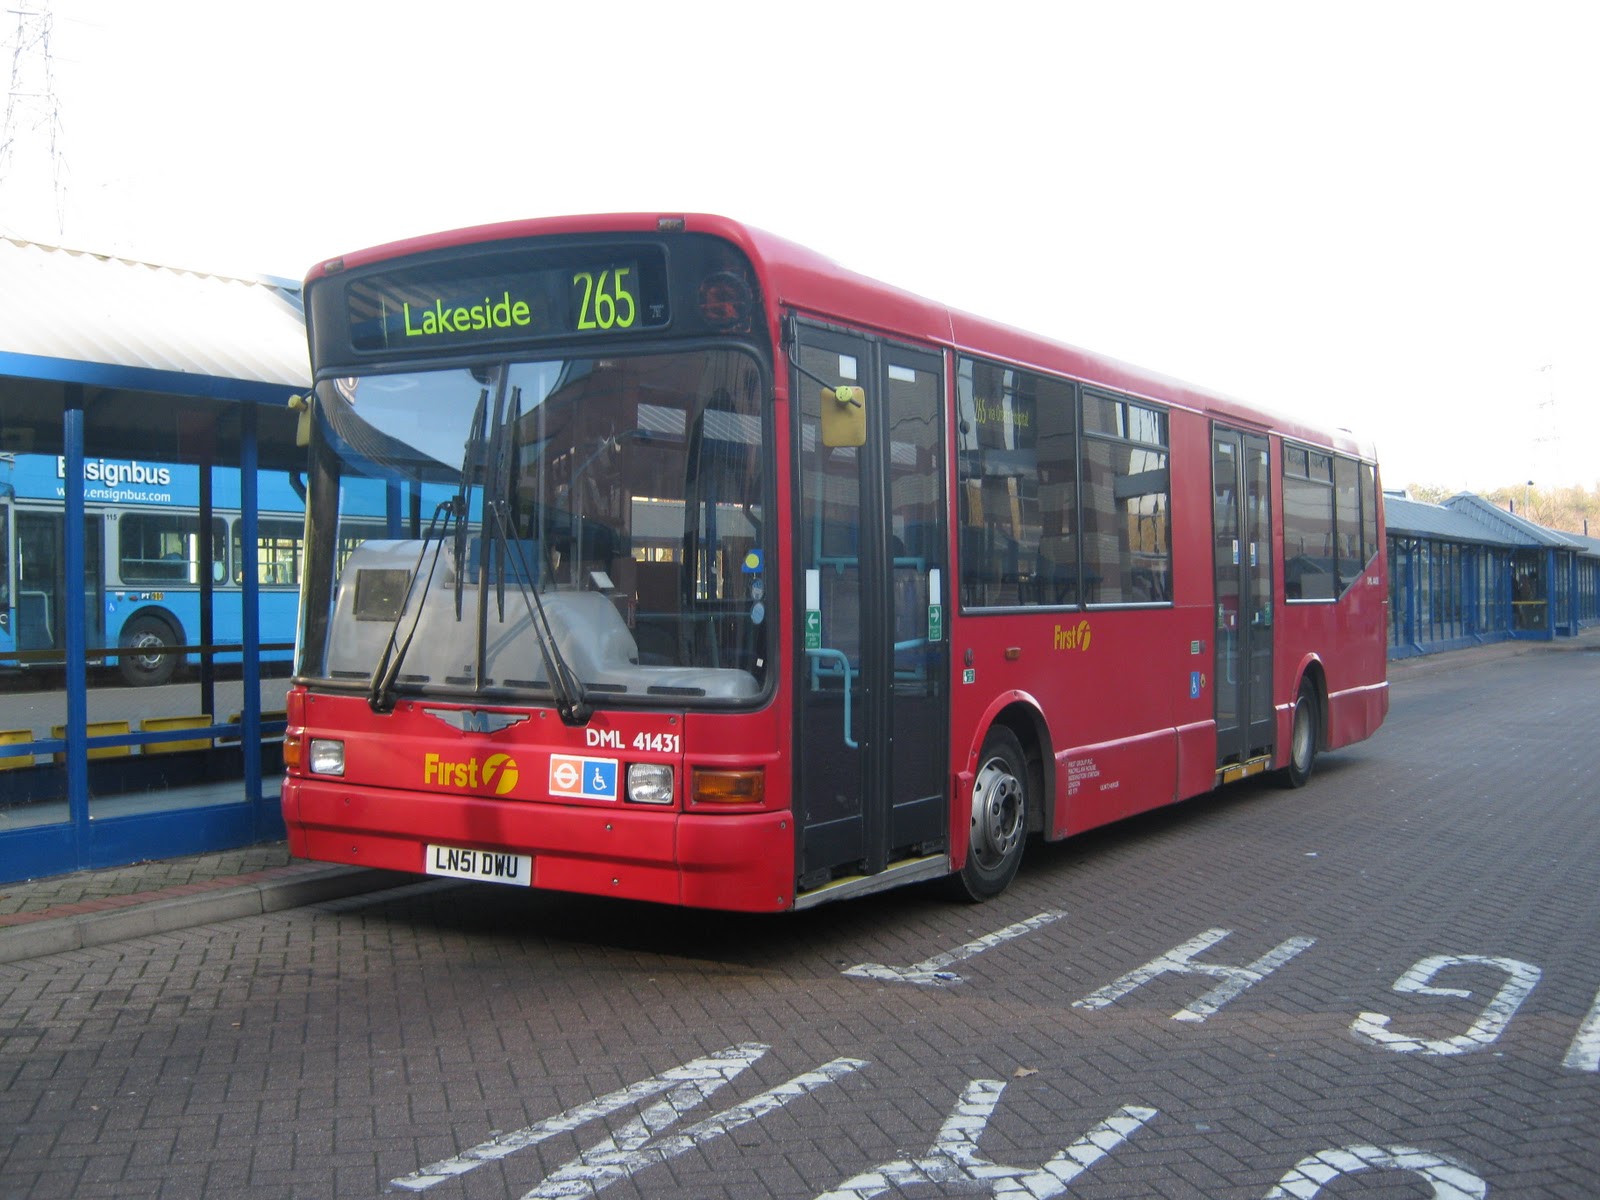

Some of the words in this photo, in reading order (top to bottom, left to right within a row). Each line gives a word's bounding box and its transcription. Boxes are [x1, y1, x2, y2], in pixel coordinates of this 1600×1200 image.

[403, 291, 531, 336] Lakeside
[573, 267, 636, 330] 265
[57, 456, 171, 487] Esignbus
[56, 487, 171, 502] w.ensignbus.com
[1054, 624, 1077, 650] First
[586, 728, 626, 749] DML
[633, 731, 680, 754] 41431
[424, 752, 479, 789] First
[435, 848, 477, 873] LN51
[481, 853, 519, 878] DWU
